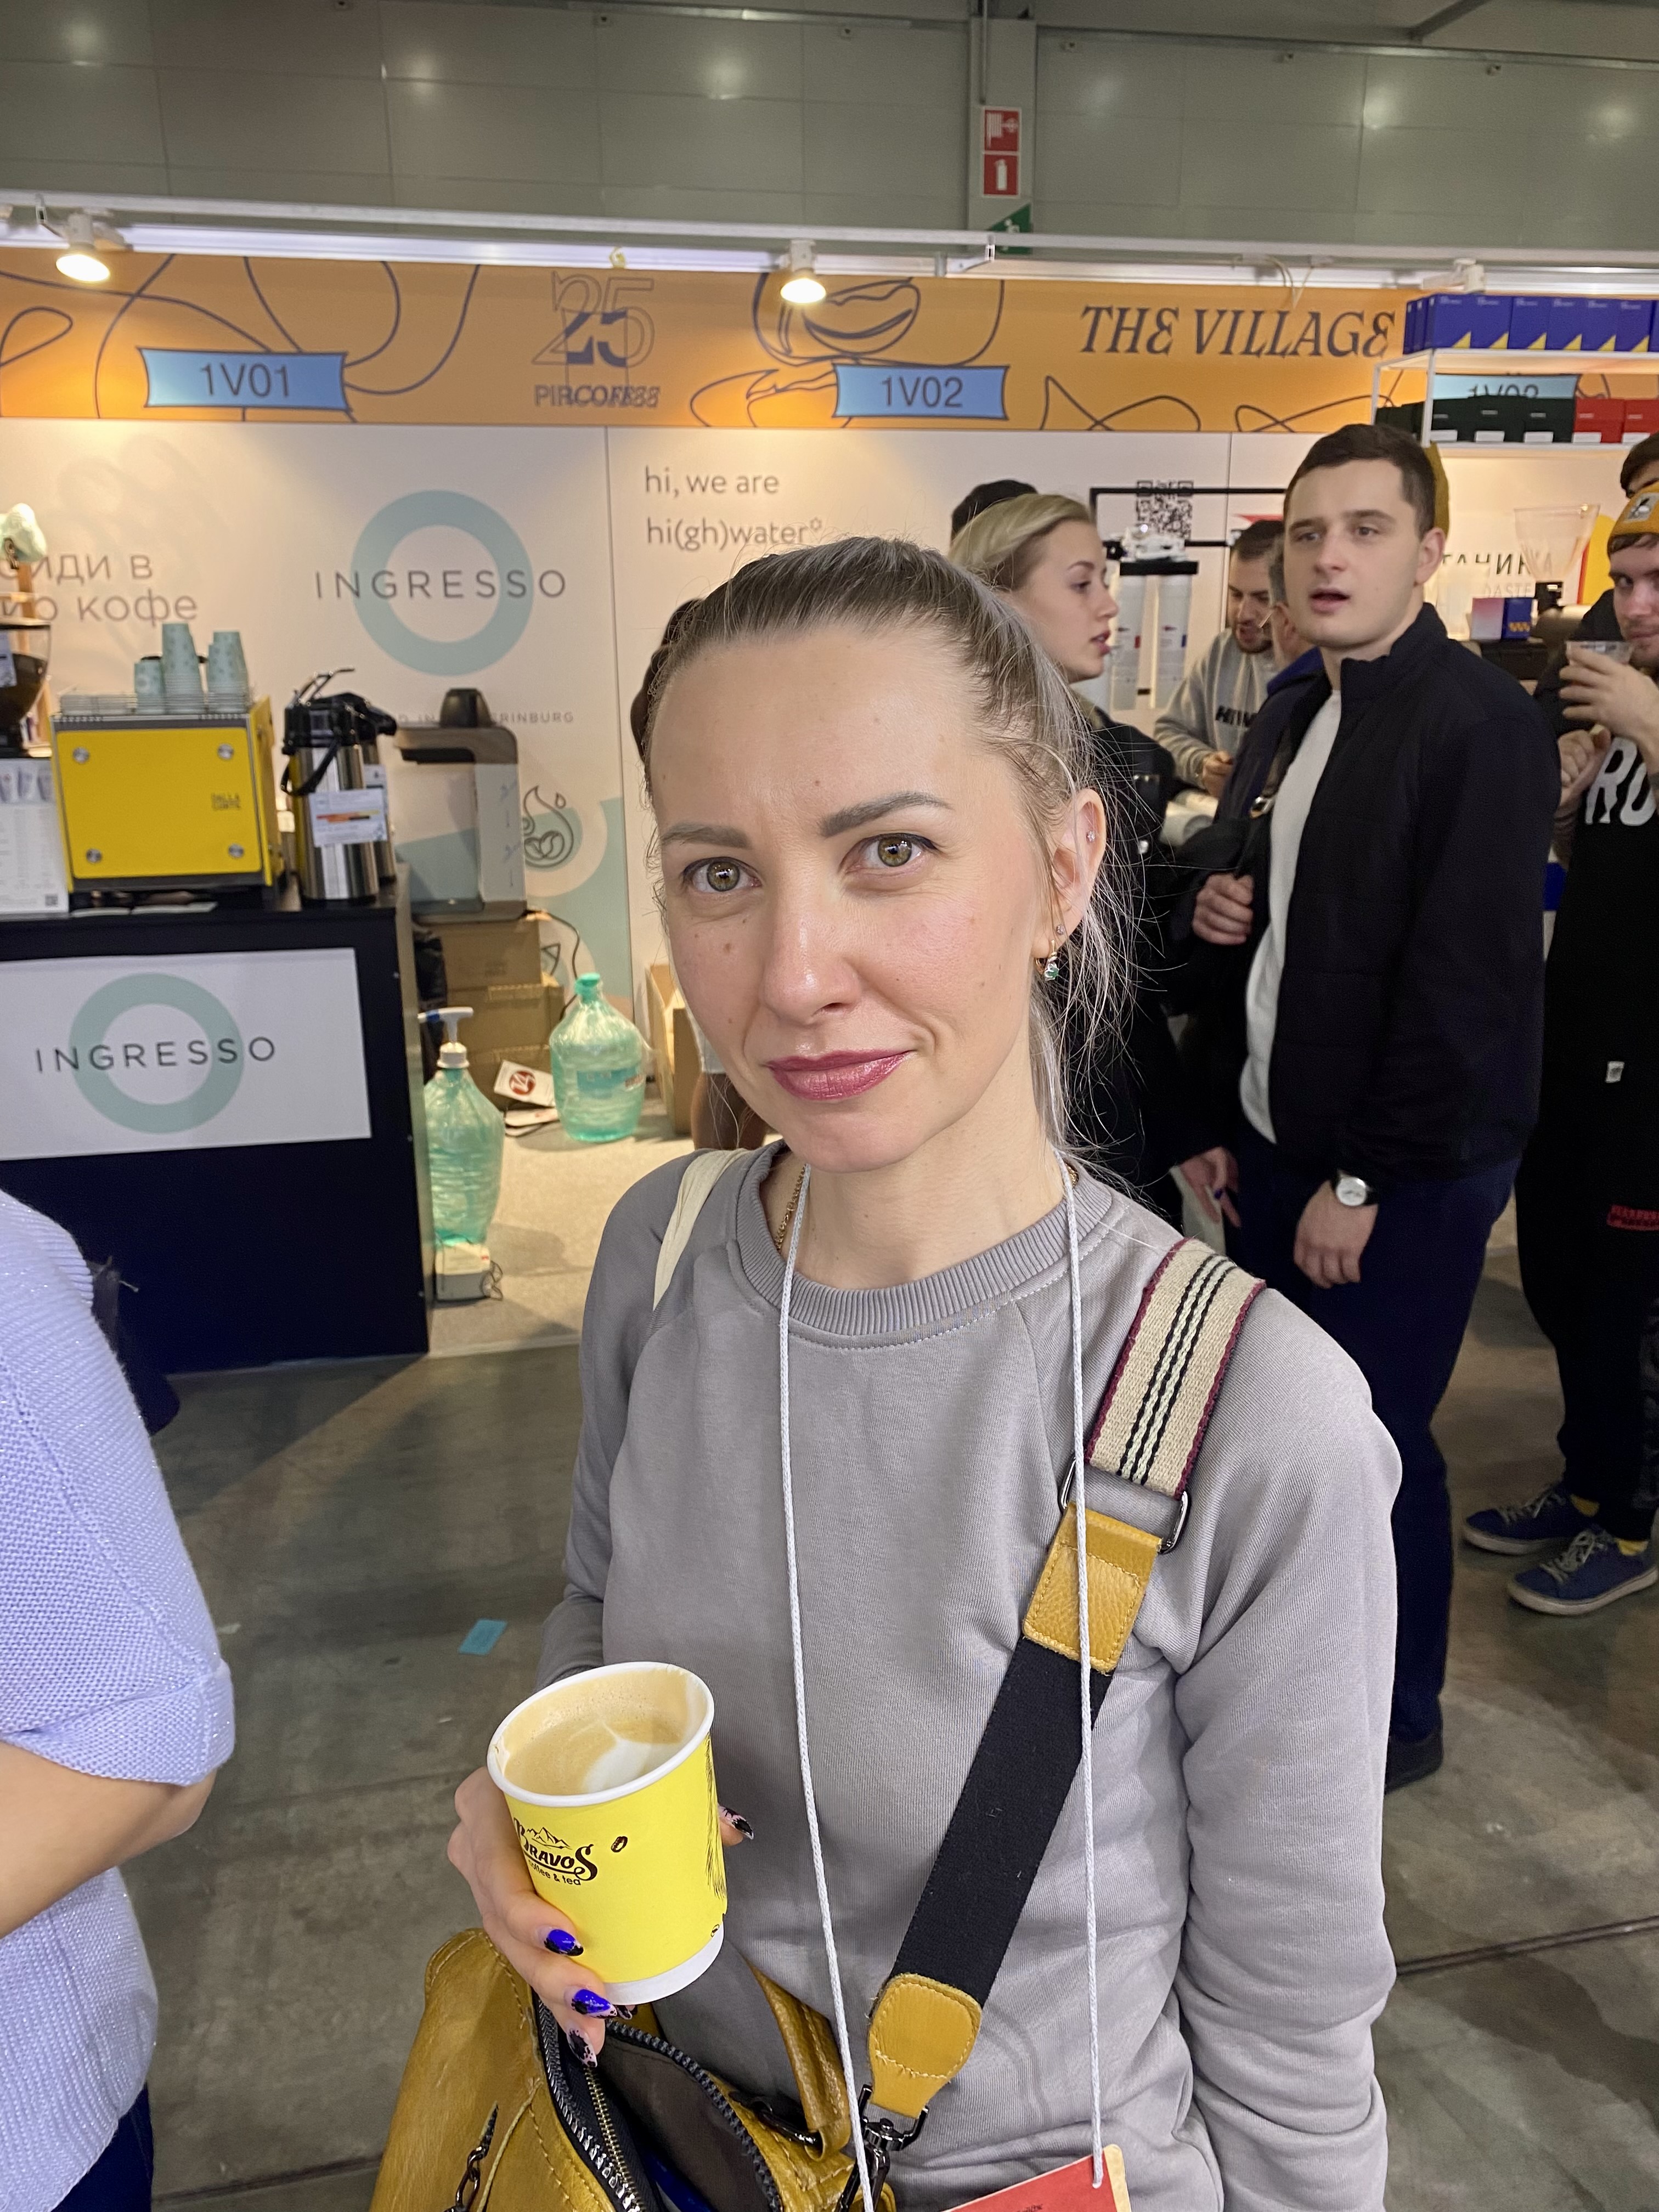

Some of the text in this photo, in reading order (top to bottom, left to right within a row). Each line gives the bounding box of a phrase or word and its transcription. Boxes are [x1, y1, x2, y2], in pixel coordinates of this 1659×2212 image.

[1080, 304, 1396, 358] THE VILLAGE
[200, 363, 290, 397] 1V01
[881, 376, 963, 408] 1V02
[645, 465, 779, 497] hi, we are
[131, 554, 153, 580] в
[315, 569, 566, 599] INGRESSO
[77, 588, 198, 628] кофе
[35, 1036, 275, 1073] INGRESSO
[552, 1873, 561, 1883] &
[562, 1875, 582, 1886] tea
